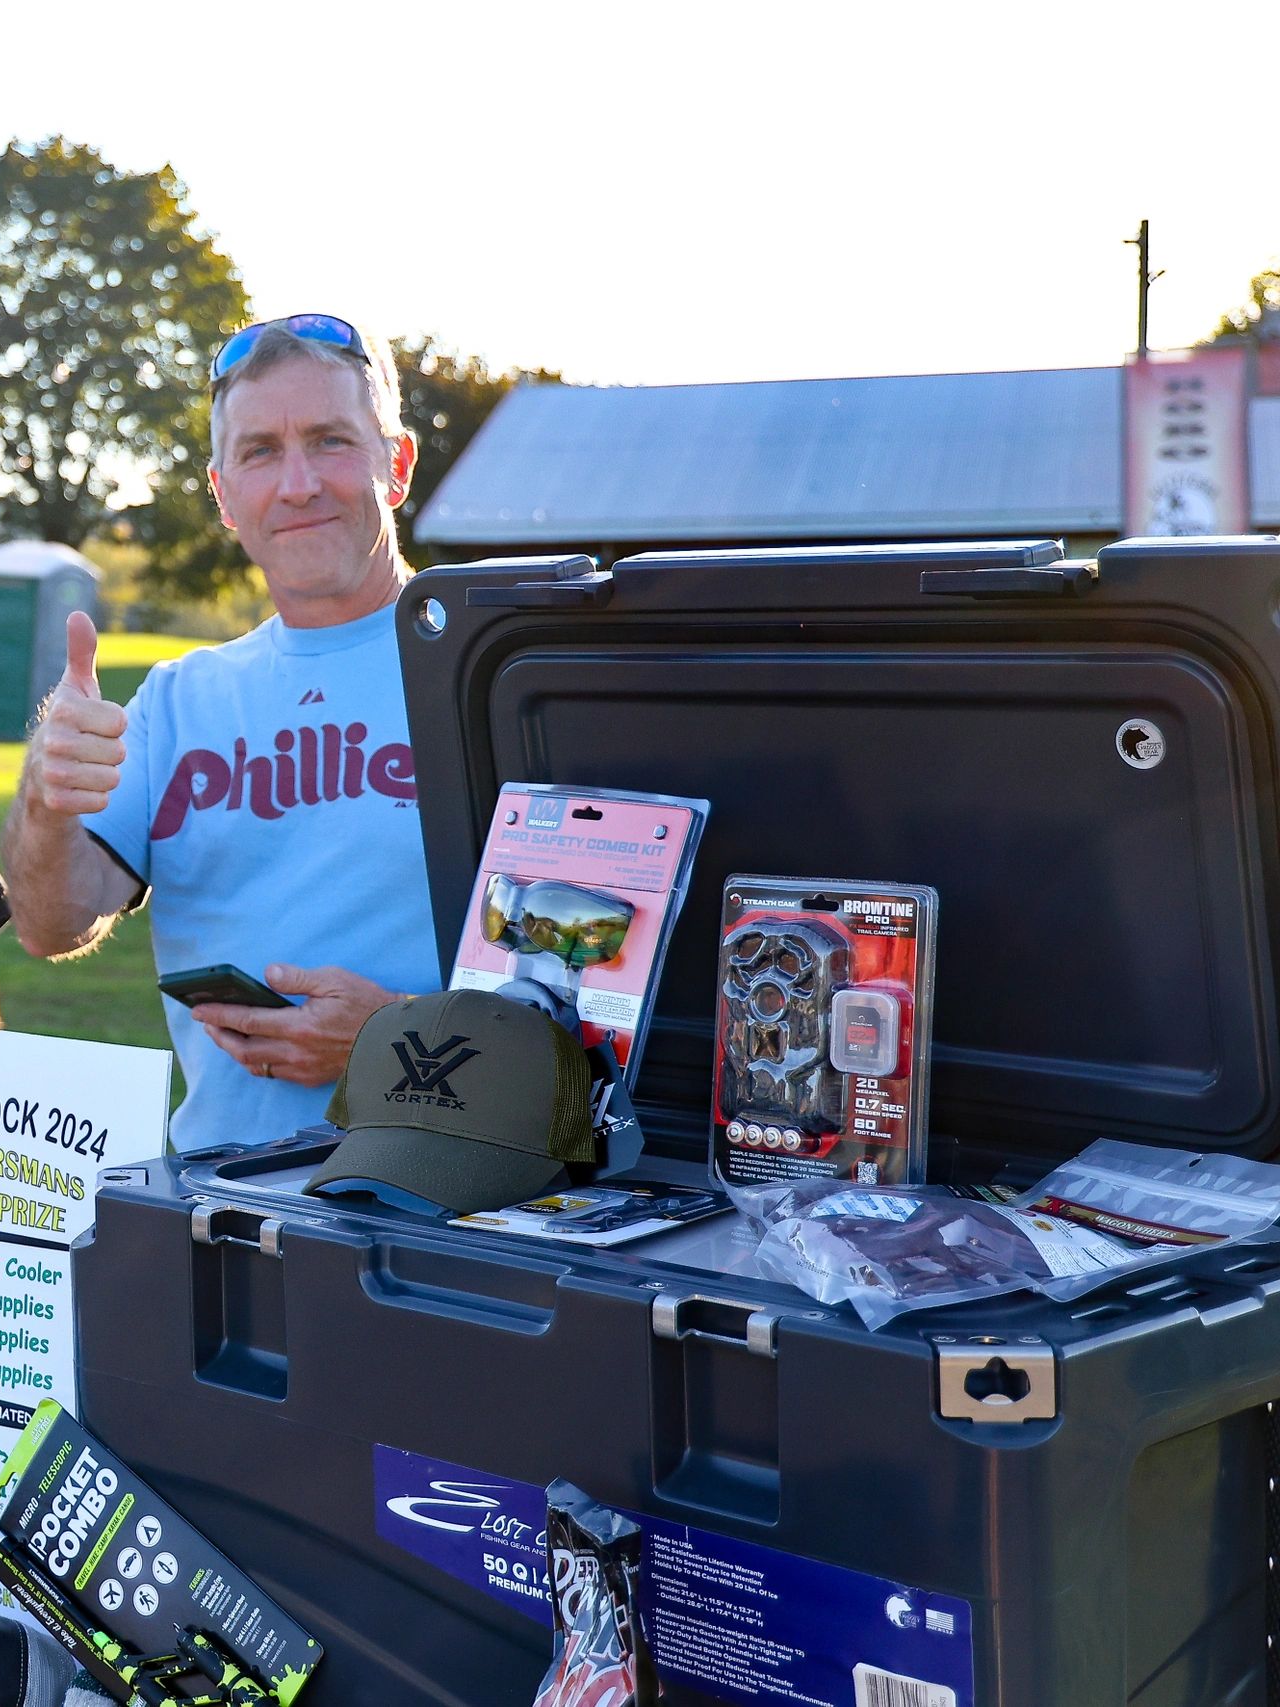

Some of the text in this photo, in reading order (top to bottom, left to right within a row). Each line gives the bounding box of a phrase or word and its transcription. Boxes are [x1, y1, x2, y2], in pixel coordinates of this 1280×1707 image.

[149, 721, 418, 841] phillie
[501, 829, 528, 842] PRO
[531, 833, 585, 848] SAFETY
[587, 838, 640, 855] COMBO
[641, 844, 667, 857] KIT
[742, 898, 795, 908] STEALTH CAM
[843, 899, 914, 917] BROWTINE
[865, 915, 890, 925] PRO
[880, 925, 909, 933] INFRARED
[873, 929, 898, 937] CAMERA
[584, 1002, 636, 1017] PROTECTION
[592, 993, 631, 1007] MAXIMUM
[855, 1077, 878, 1090] 20
[855, 1088, 890, 1097] MEGAPIXEL
[383, 1091, 468, 1112] VORTEX
[854, 1109, 881, 1117] TRIGGER
[855, 1097, 907, 1114] 0.7 SEC.
[45, 1107, 109, 1163] 2024
[853, 1129, 892, 1139] FOOT RANGE
[854, 1118, 876, 1130] 60
[1094, 1214, 1133, 1232] WAGON
[1134, 1223, 1177, 1239] WHEELS
[5, 1257, 63, 1286] Cooler
[18, 1496, 39, 1530] MICRO
[38, 1440, 73, 1494] TELESCOPIC
[28, 1445, 99, 1561] POCKET
[48, 1467, 118, 1577] COMBO
[480, 1511, 532, 1540] LOST
[76, 1496, 133, 1588] TRAVEL HIKE CAMP KAYAK CANOE
[480, 1532, 547, 1557] FISHING GEAR AND
[653, 1534, 671, 1543] Made
[679, 1541, 694, 1550] USA
[483, 1552, 528, 1581] 50 Q
[654, 1542, 765, 1579] 100% Satisfaction Lifetime Warranty
[654, 1551, 675, 1562] Tested
[683, 1559, 703, 1570] Seven
[703, 1565, 720, 1575] Days
[720, 1569, 730, 1577] Ice
[731, 1572, 762, 1586] Retention
[488, 1574, 544, 1600] PREMIUM
[651, 1572, 689, 1588] Dimensions:
[654, 1560, 672, 1570] Holds
[701, 1572, 718, 1583] Cans
[718, 1577, 734, 1588] With
[744, 1584, 758, 1594] Lbs.
[768, 1591, 778, 1600] Ice
[11, 1583, 77, 1650] Take it Everywhere!
[692, 1634, 724, 1650] Rubberize
[724, 1644, 754, 1659] T-Handle
[754, 1653, 780, 1667] Latches
